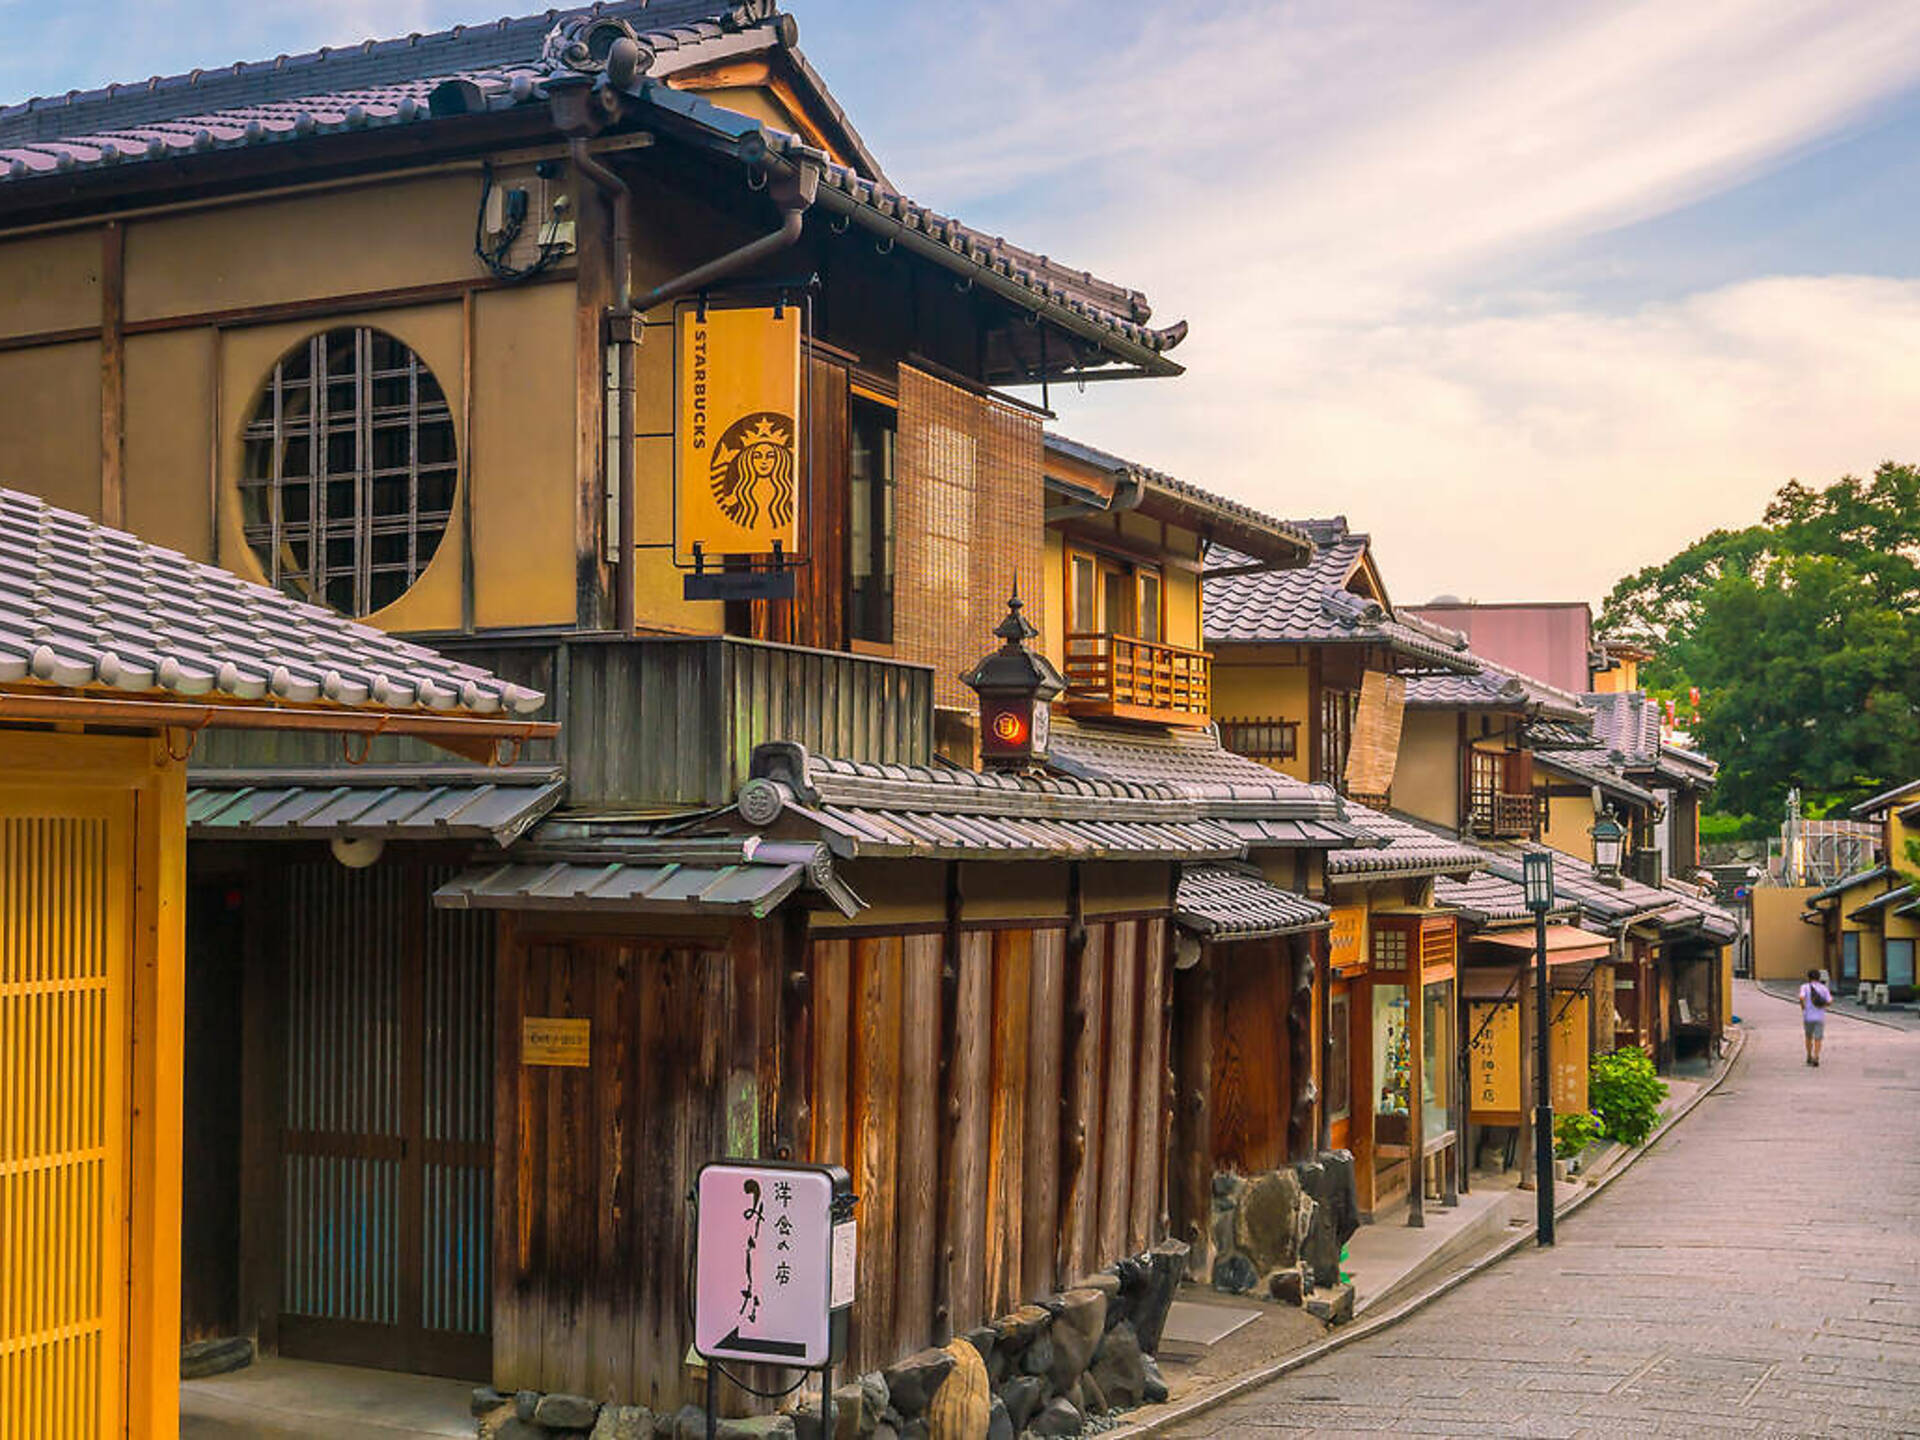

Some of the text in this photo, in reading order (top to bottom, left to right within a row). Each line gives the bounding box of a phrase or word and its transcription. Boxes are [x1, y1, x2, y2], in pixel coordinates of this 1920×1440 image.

[694, 330, 706, 449] STARBUCKS
[774, 1181, 793, 1286] 洋食の店
